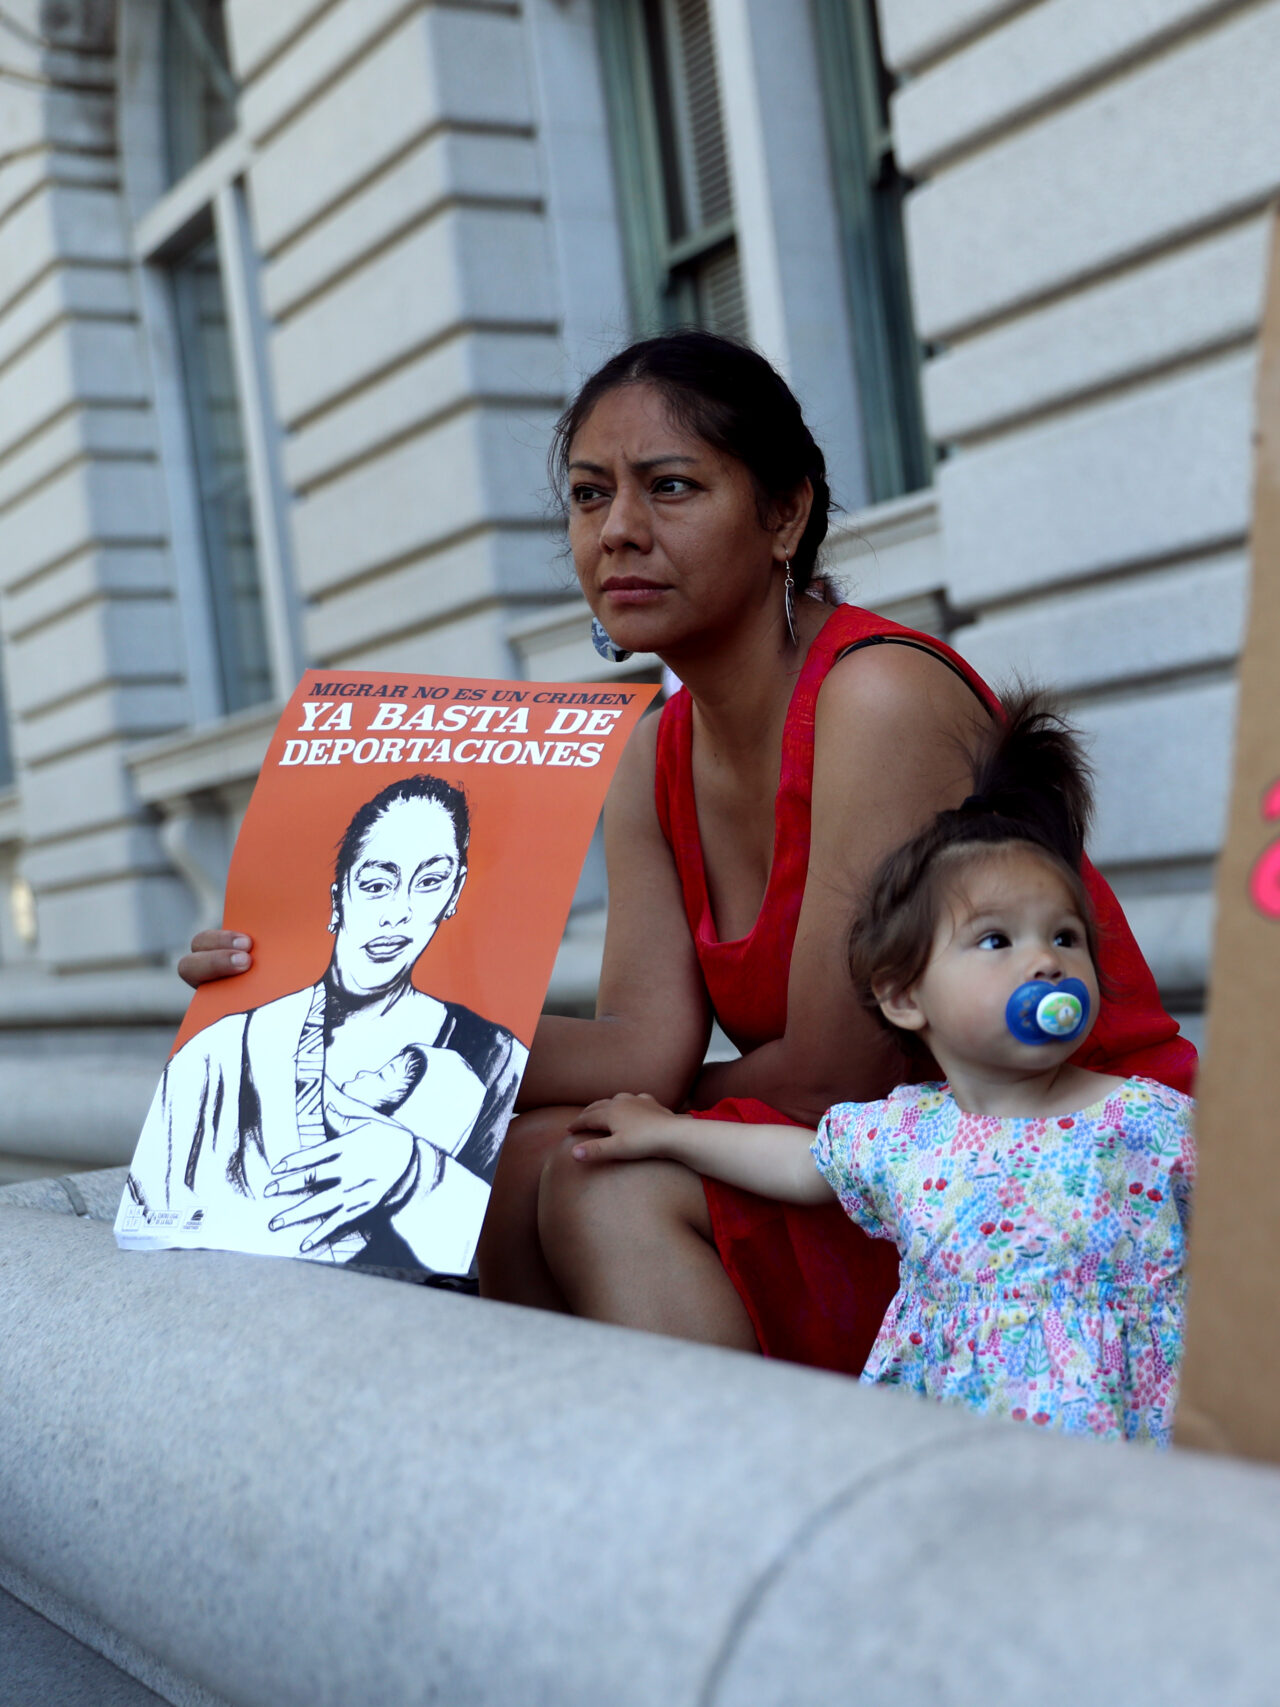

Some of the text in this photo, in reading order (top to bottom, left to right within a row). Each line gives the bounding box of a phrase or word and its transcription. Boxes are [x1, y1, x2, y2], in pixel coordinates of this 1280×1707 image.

[309, 683, 636, 705] MIGRAR NO ES UN CRIMEN
[297, 702, 623, 735] YA BASTA DE
[278, 738, 604, 767] DEPORTACIONES
